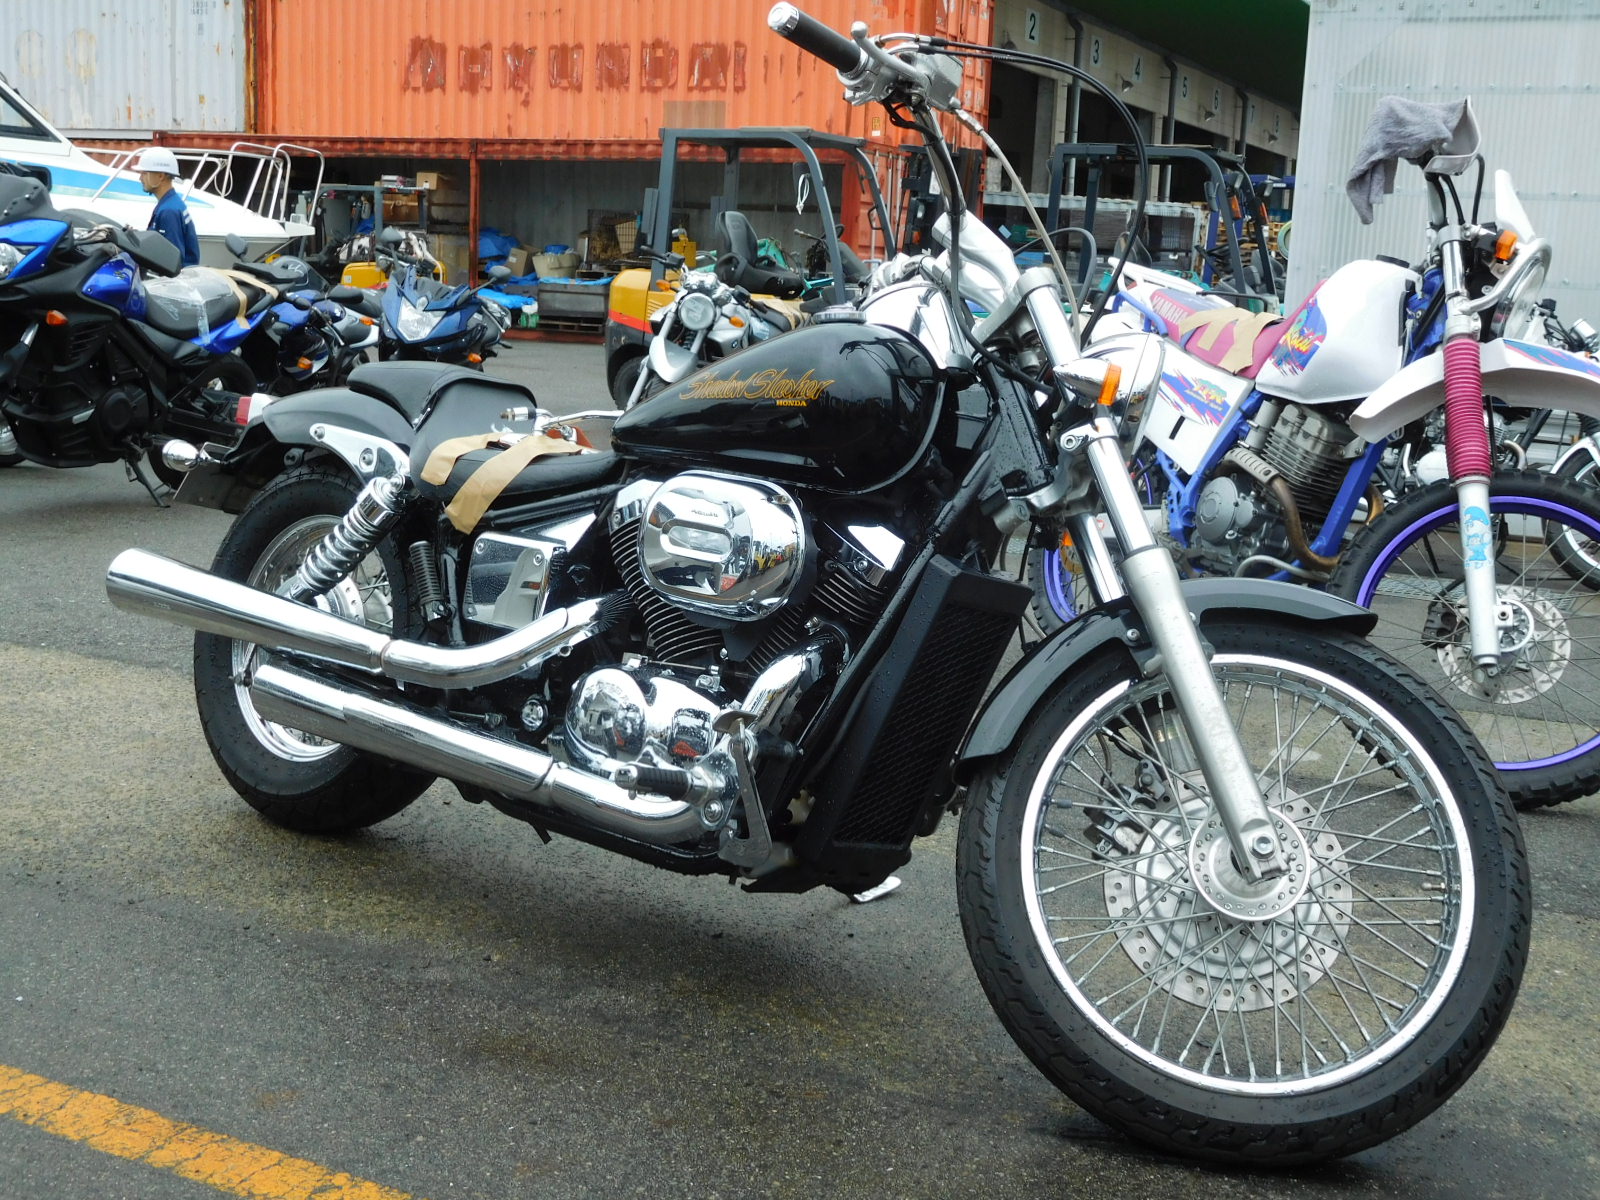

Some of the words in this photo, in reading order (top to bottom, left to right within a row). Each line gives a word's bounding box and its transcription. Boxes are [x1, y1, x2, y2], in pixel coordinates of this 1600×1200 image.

[1028, 12, 1037, 41] 2
[1093, 39, 1101, 65] 3
[1134, 57, 1142, 80] 4
[1181, 76, 1189, 98] 5
[744, 368, 835, 400] Slasher
[776, 399, 807, 407] HONDA
